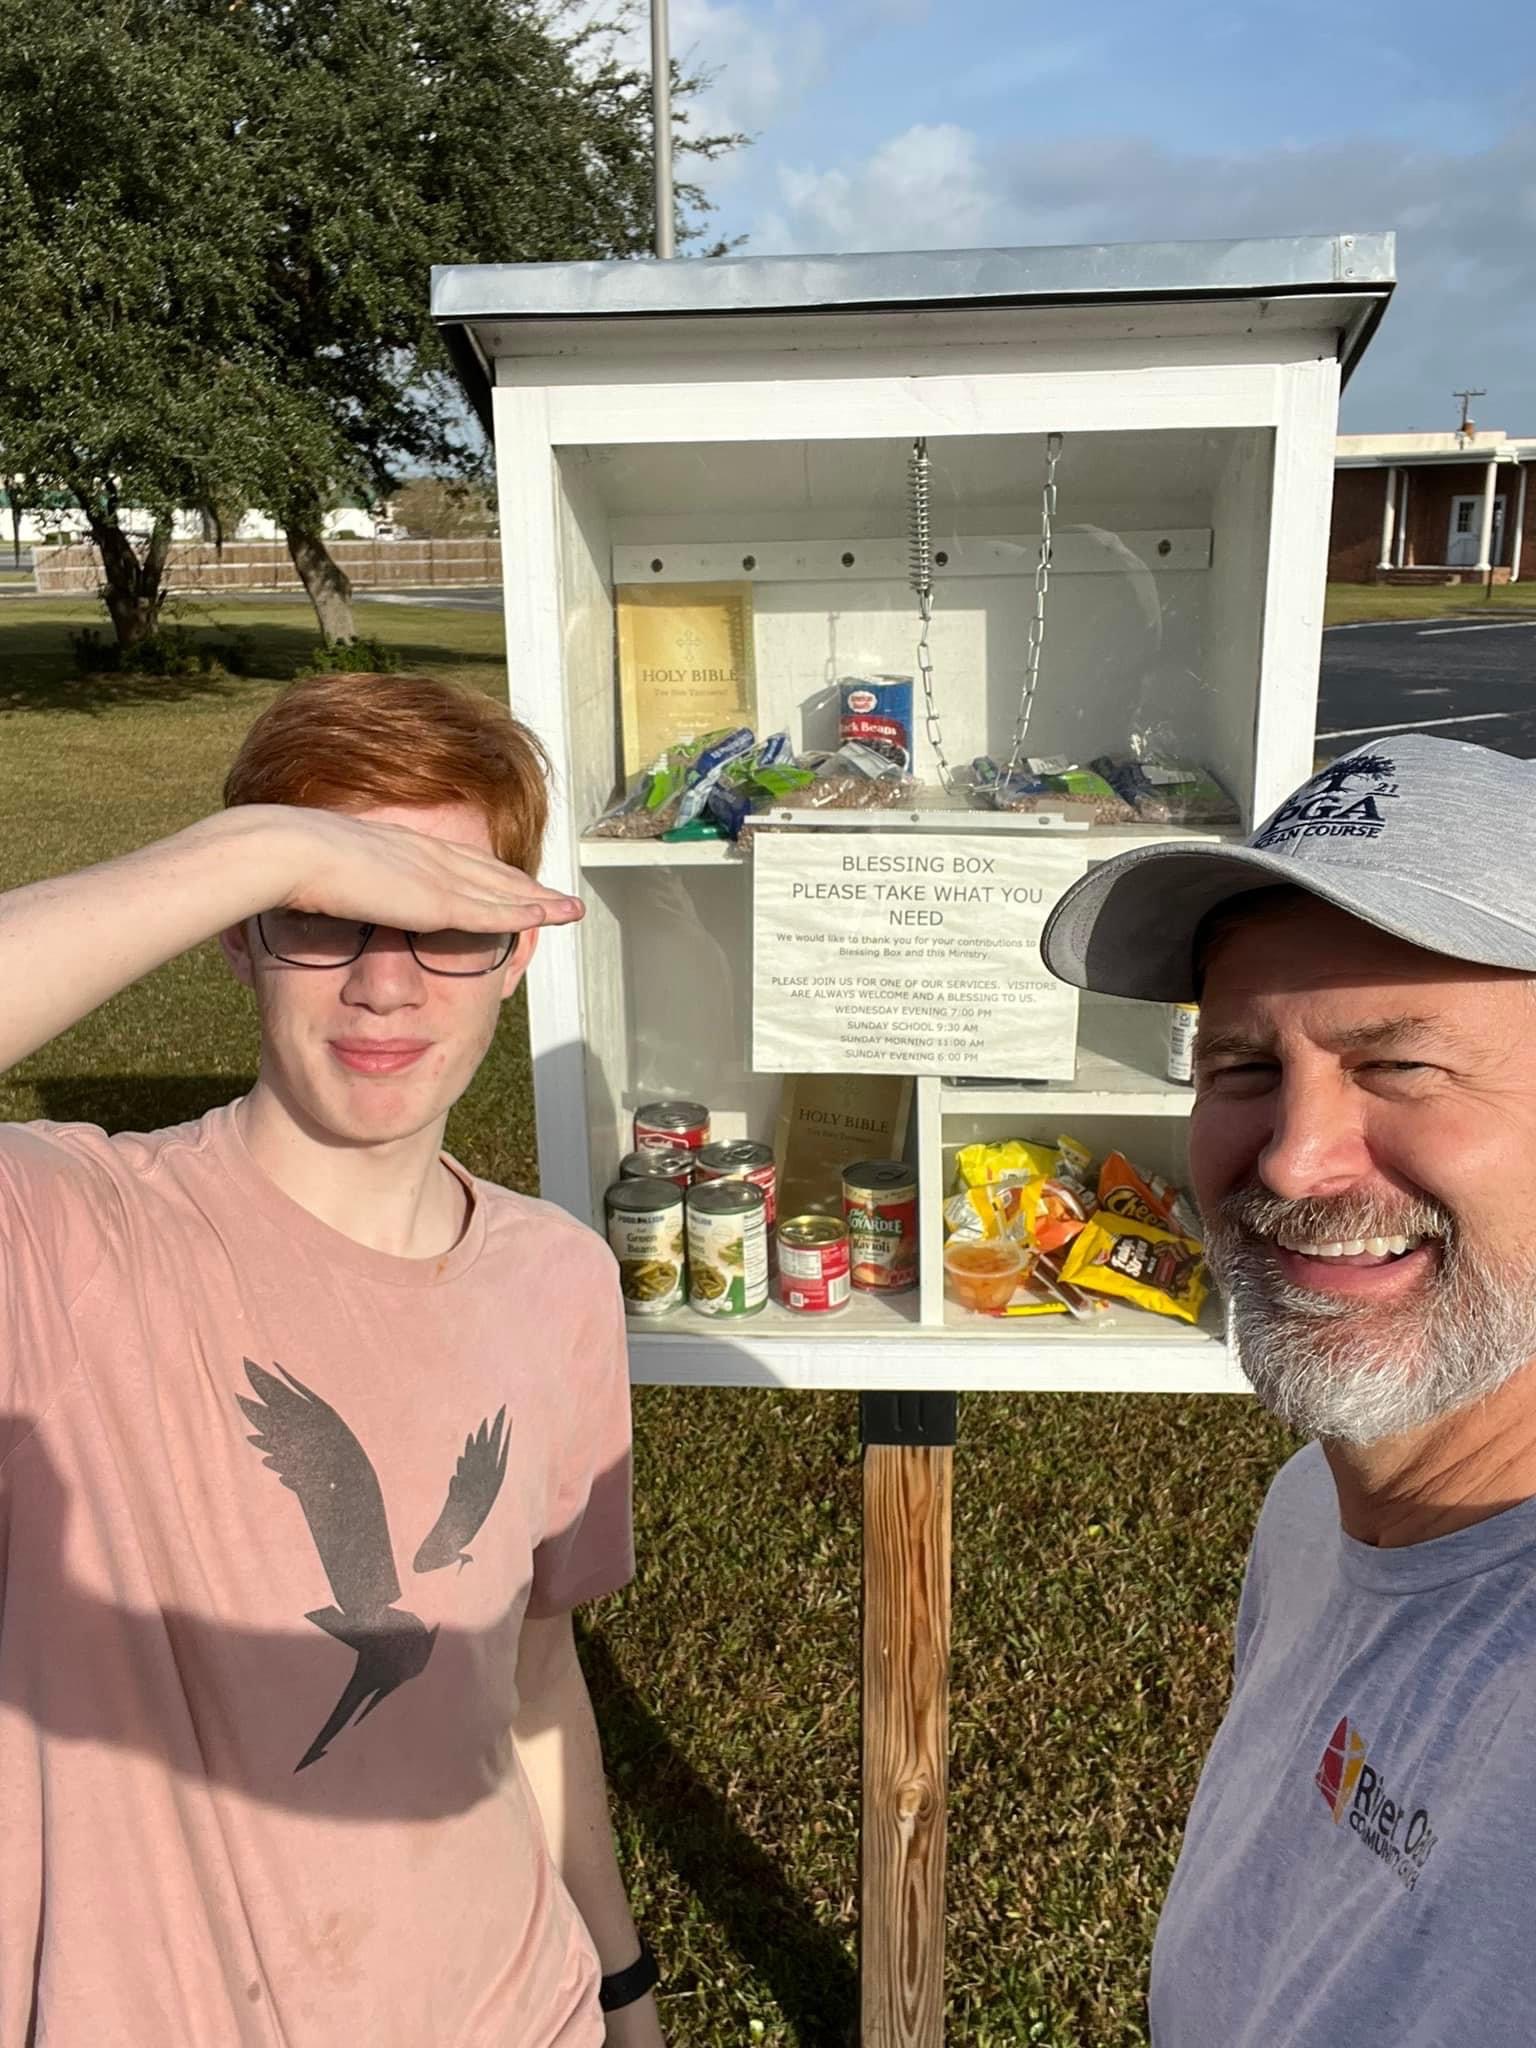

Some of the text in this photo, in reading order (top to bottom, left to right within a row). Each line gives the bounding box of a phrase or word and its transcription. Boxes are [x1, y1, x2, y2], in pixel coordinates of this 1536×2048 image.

[642, 669, 738, 682] HOLY BIBLE
[860, 721, 897, 736] Beans
[1373, 782, 1400, 794] 21
[1261, 795, 1386, 836] PGA
[1303, 825, 1382, 839] COURSE
[842, 856, 995, 874] BLESSING BOX
[792, 883, 1043, 904] PLEASE TAKE WHAT YOU
[889, 910, 944, 927] NEED
[776, 932, 1037, 948] We would like to thank you for your contributions to
[839, 947, 880, 958] Blessing
[883, 947, 902, 957] Box
[904, 948, 924, 957] and
[926, 948, 946, 958] this
[771, 976, 1057, 991] PLEASE JOIN US FOR ONE OF OUR SERVICES. VISITORS
[790, 989, 811, 999] ARE
[814, 989, 856, 999] ALWAYS
[858, 990, 910, 1001] WELCOME
[912, 991, 934, 1001] AND
[936, 991, 945, 1001] A
[947, 992, 999, 1002] BLESSING
[1002, 993, 1017, 1003] TO
[835, 1005, 993, 1018] WEDNESDAY EVENING 7:00 PM
[847, 1020, 979, 1033] SUNDAY SCHOOL 9:30 AM
[840, 1034, 985, 1048] SUNDAY MORNING 11:00 AM
[845, 1048, 979, 1062] SUNDAY EVENING 6:00 PM
[799, 1108, 889, 1133] HOLY BIBLE
[626, 1233, 658, 1242] Green
[626, 1244, 658, 1254] Beans
[1354, 1764, 1405, 1841] River
[1349, 1810, 1400, 1872] COMUNTY
